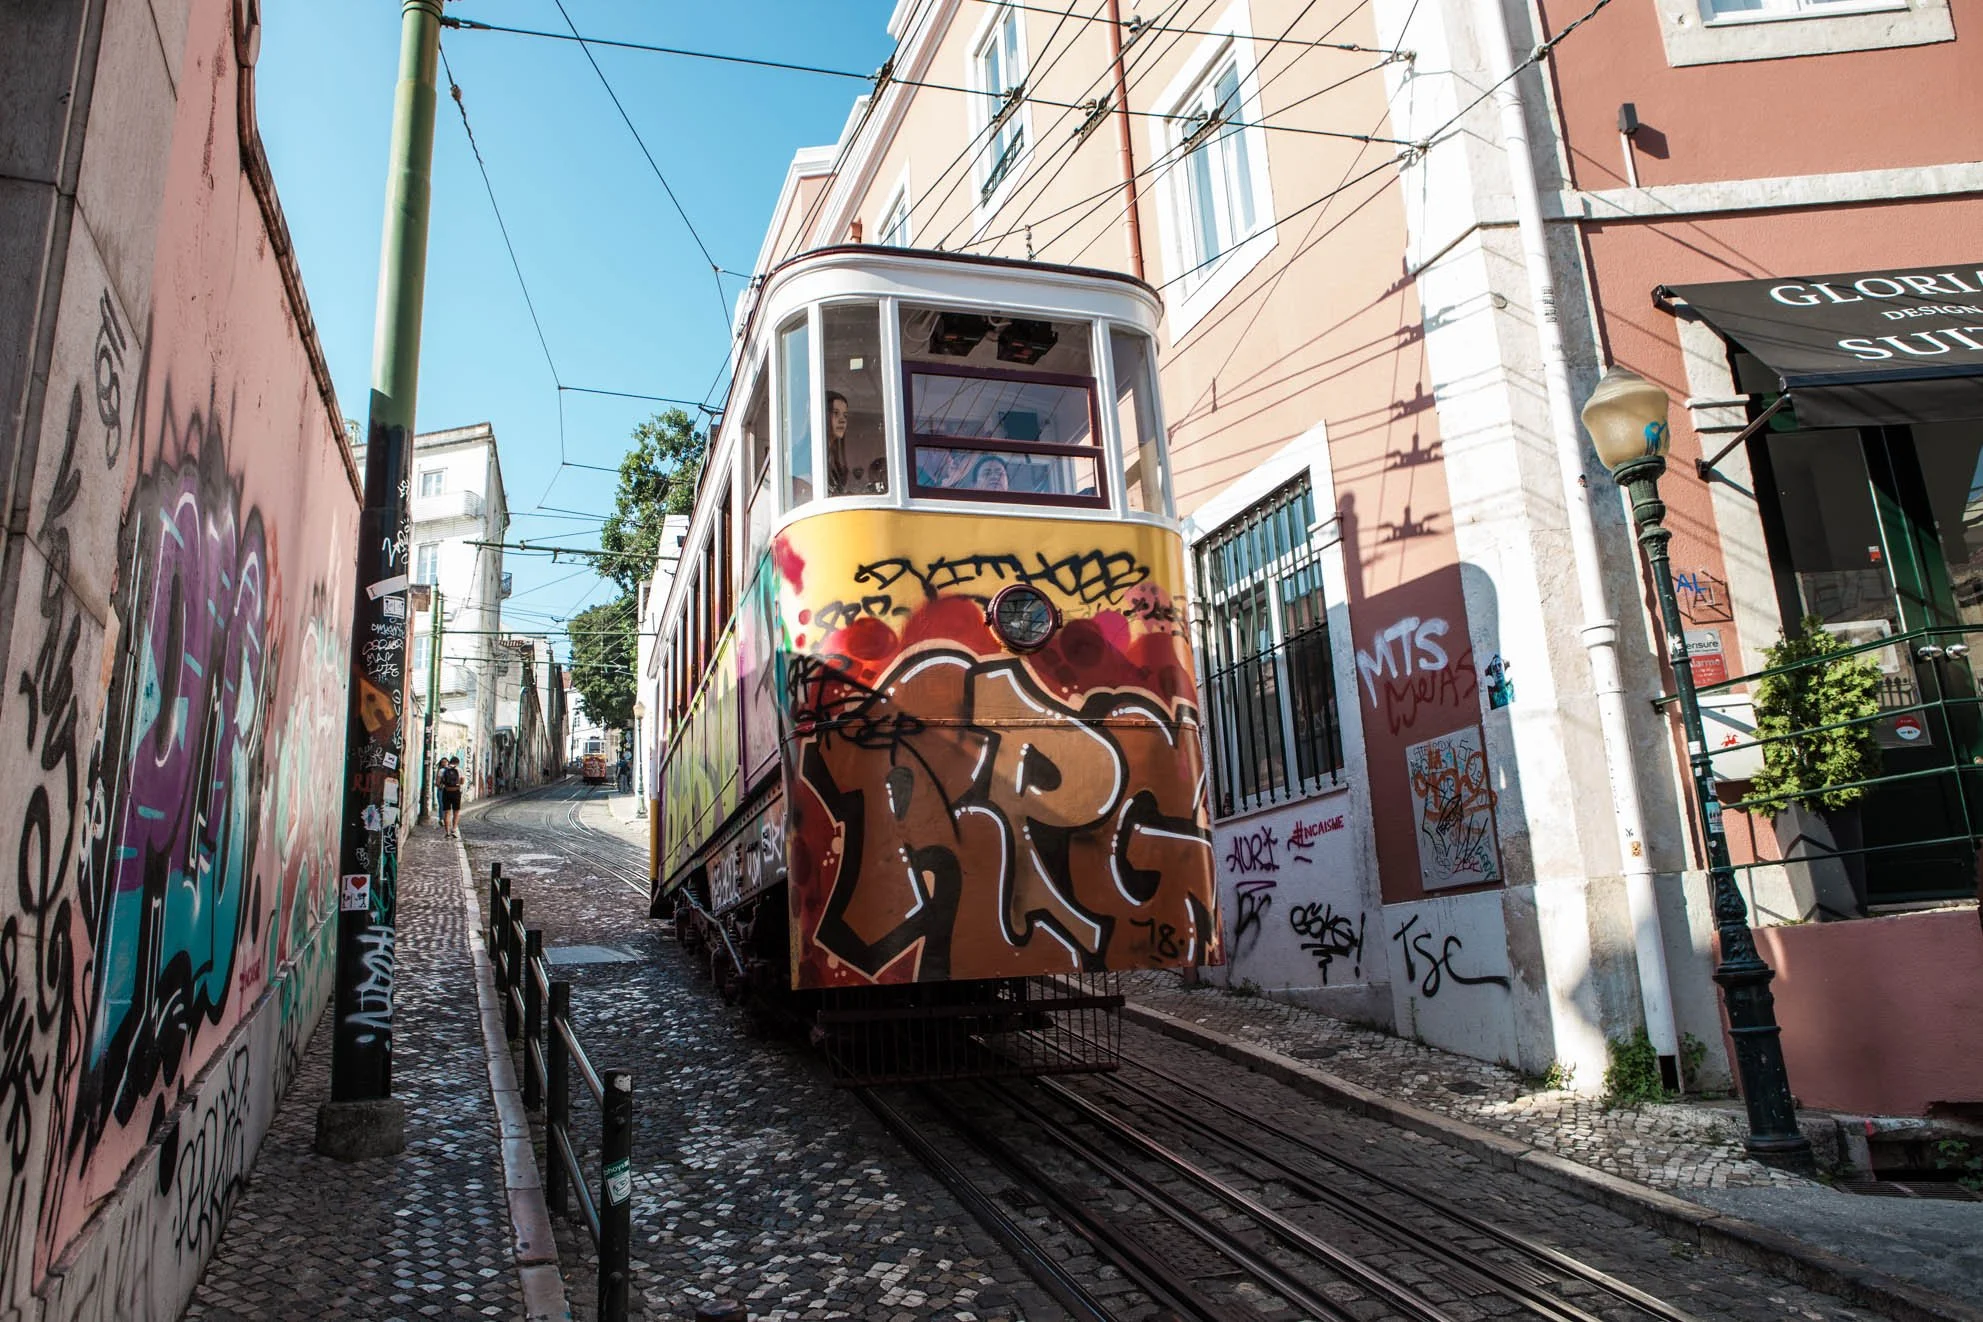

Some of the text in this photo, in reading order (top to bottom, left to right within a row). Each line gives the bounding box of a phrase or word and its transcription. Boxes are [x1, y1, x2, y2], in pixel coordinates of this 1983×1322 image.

[1770, 270, 1983, 307] GLORI
[1881, 305, 1983, 321] DESIGN
[1838, 326, 1983, 361] SUI
[1676, 573, 1706, 592] AL
[1356, 616, 1449, 709] MTS
